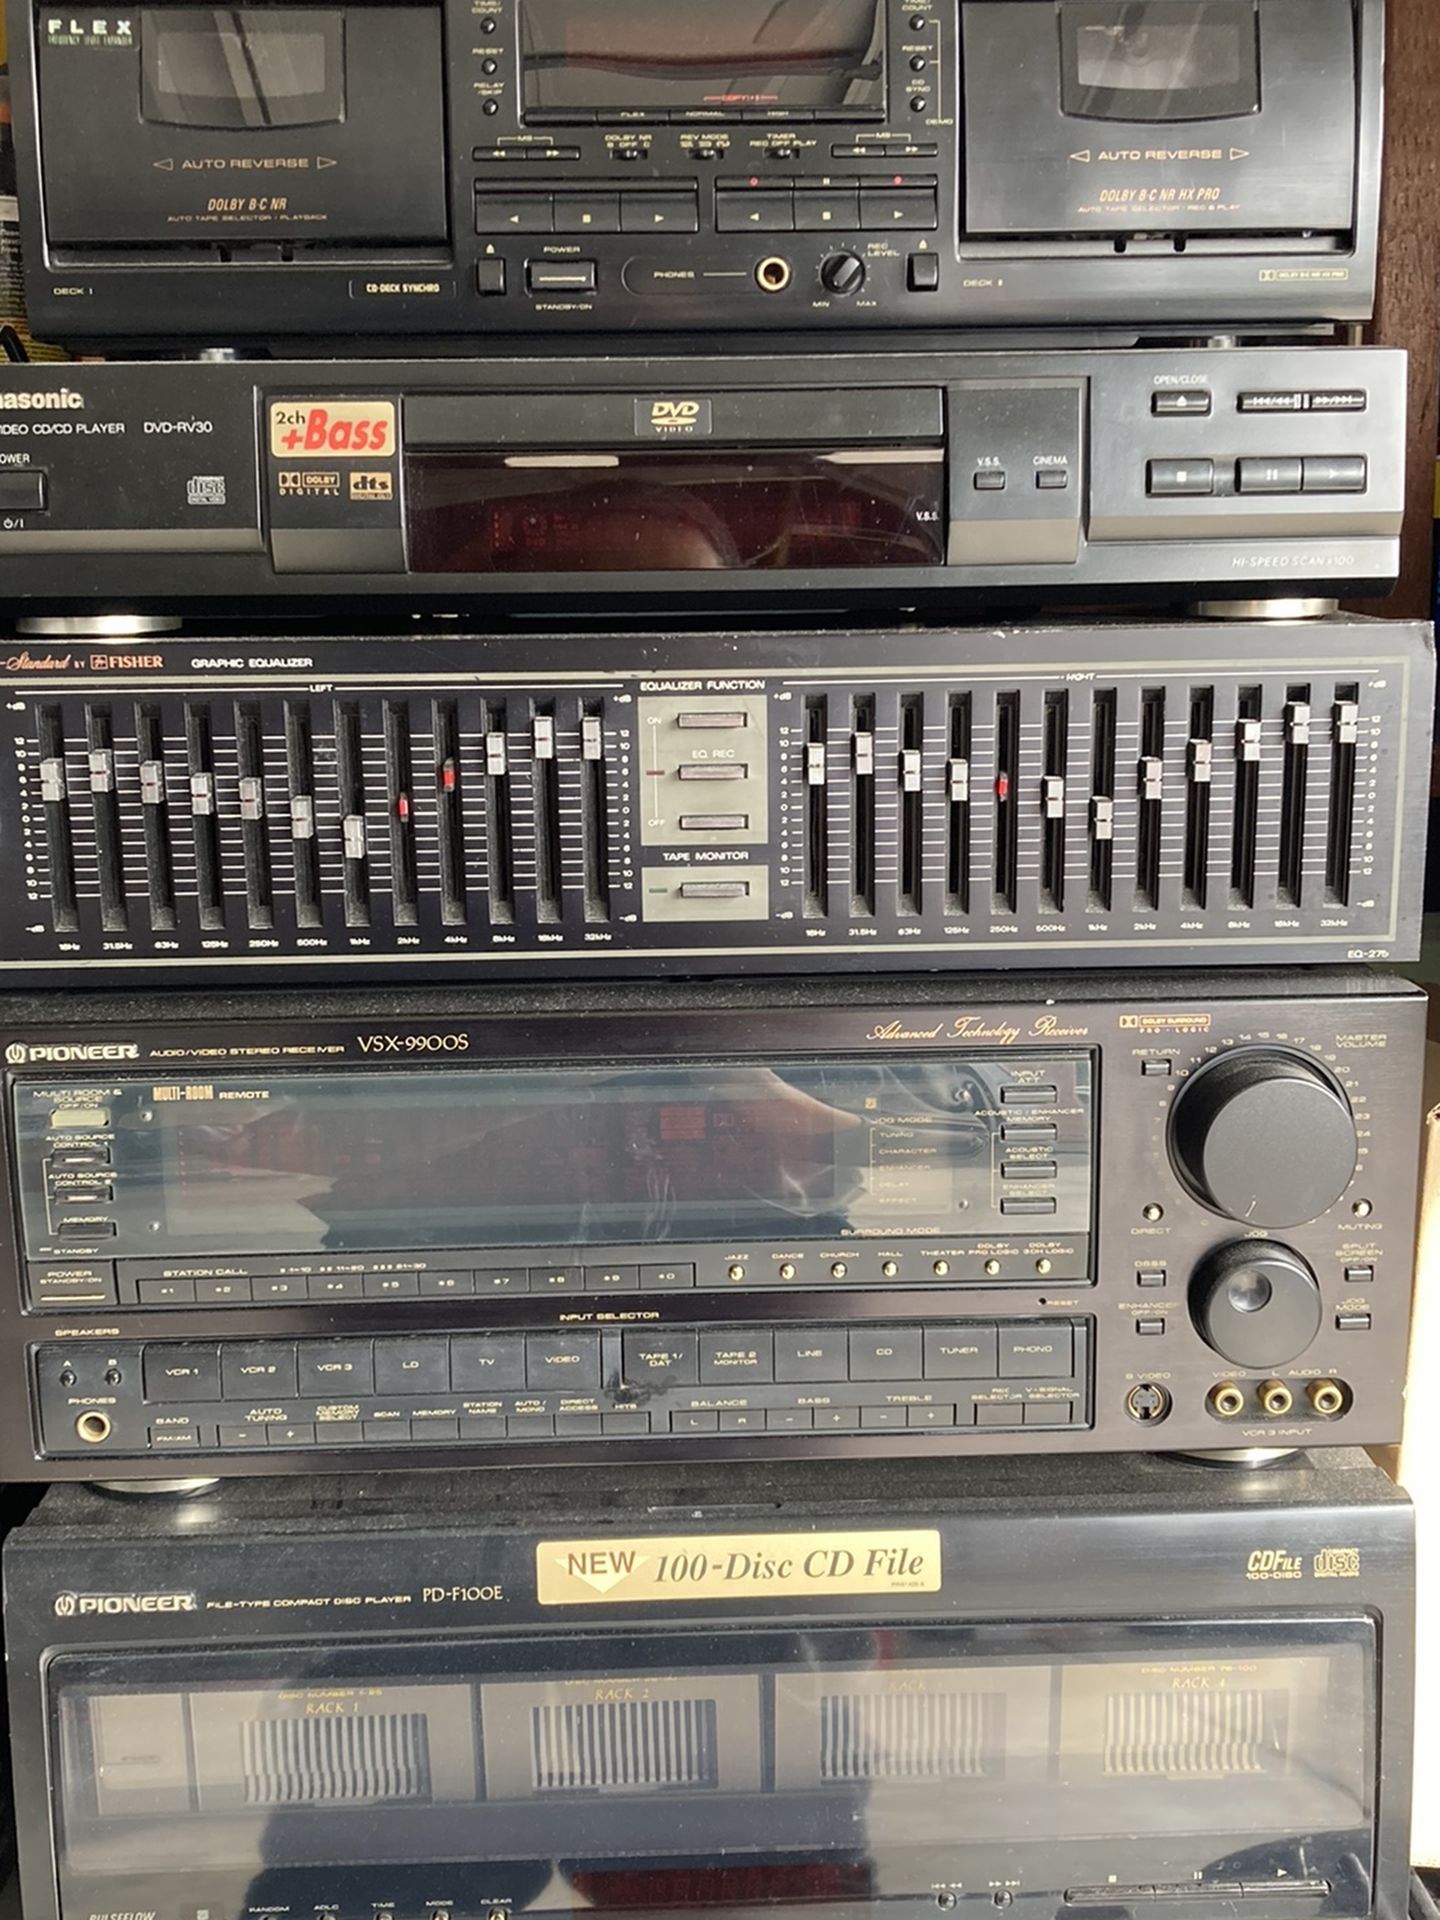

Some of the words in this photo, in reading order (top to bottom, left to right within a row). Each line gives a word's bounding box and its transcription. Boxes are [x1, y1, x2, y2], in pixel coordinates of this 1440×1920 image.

[48, 19, 131, 34] FLEX
[1098, 151, 1141, 161] AUTO
[1145, 149, 1222, 160] REVERSE
[182, 159, 226, 169] AUTO
[230, 158, 309, 169] REVERSE
[1100, 189, 1136, 202] DOLBY
[1159, 189, 1176, 201] NR
[1178, 188, 1195, 201] HX
[1197, 187, 1221, 200] PRO
[207, 198, 245, 211] DOLBY
[270, 198, 288, 210] NR
[279, 213, 328, 221] PLAYBACK
[654, 270, 694, 278] PHONES
[54, 287, 84, 295] DECK
[1153, 375, 1208, 385] OPEN/CLOSE
[651, 402, 699, 417] DVD
[276, 411, 306, 425] 2ch
[32, 423, 72, 435] CD/CD
[76, 422, 125, 434] PLAYER
[144, 421, 213, 434] DVD-RV30
[1033, 456, 1067, 465] CINEMA
[306, 474, 336, 485] DOLBY
[353, 476, 389, 492] dts
[279, 489, 340, 497] DIGITAL
[1232, 557, 1289, 568] HI-SPEED
[1293, 556, 1324, 567] SCAN
[5, 652, 70, 671] Standard
[109, 655, 163, 669] FISHER
[191, 658, 244, 668] GRAPHIC
[249, 658, 313, 668] EQUALIZER
[310, 684, 333, 693] LEFT
[640, 681, 702, 691] EQUALIZER
[707, 680, 766, 690] FUNCTION
[647, 716, 661, 725] ON
[714, 749, 735, 758] REC
[648, 818, 665, 827] OFF
[663, 852, 690, 861] TAPE
[696, 851, 749, 861] MONITOR
[866, 1020, 944, 1040] Advanced
[946, 1016, 1021, 1044] Technology
[1027, 1015, 1090, 1037] Receiver
[1336, 1033, 1387, 1042] MASTER
[357, 1034, 470, 1052] VSX-9900S
[30, 1044, 140, 1061] PIONEER
[149, 1047, 226, 1057] AUDIO/VIDEO
[229, 1047, 279, 1056] STEREO
[282, 1046, 345, 1055] RECEIVER
[1132, 1047, 1181, 1056] RETURN
[153, 1086, 214, 1101] MULTI-ROOM
[219, 1090, 270, 1099] REMOTE
[880, 1147, 937, 1155] CHARACTER
[1337, 1222, 1383, 1231] MUTING
[841, 1227, 904, 1236] SURROUND
[1131, 1227, 1172, 1236] DIRECT
[772, 1252, 804, 1260] DANCE
[48, 1270, 92, 1278] POWER
[163, 1268, 213, 1277] STATION
[216, 1267, 248, 1276] CALL
[559, 1311, 597, 1321] INPUT
[598, 1310, 660, 1320] SELECTOR
[55, 1327, 120, 1337] SPEAKERS
[796, 1349, 823, 1357] LINE
[876, 1347, 893, 1356] CD
[939, 1346, 979, 1354] TUNER
[1013, 1345, 1053, 1353] PHONO
[544, 1356, 580, 1364] VIDEO
[716, 1352, 743, 1360] TAPE
[402, 1360, 419, 1369] LD
[479, 1358, 495, 1367] TV
[649, 1359, 672, 1367] DAT
[713, 1358, 758, 1366] MONITOR
[166, 1368, 190, 1376] VCR
[241, 1366, 267, 1375] VCR
[316, 1364, 342, 1373] VCR
[1288, 1369, 1321, 1377] AUDIO
[68, 1396, 117, 1406] PHONES
[560, 1398, 595, 1406] DIRECT
[797, 1395, 830, 1405] BASS
[885, 1393, 933, 1402] TREBLE
[691, 1398, 748, 1408] BALANCE
[249, 1407, 283, 1416] AUTO
[412, 1408, 457, 1417] MEMORY
[559, 1404, 599, 1412] ACCESS
[246, 1414, 288, 1422] TUNING
[373, 1410, 400, 1418] SCAN
[156, 1416, 190, 1425] BAND
[1242, 1429, 1267, 1438] VCR
[567, 1550, 637, 1577] NEW
[652, 1551, 793, 1584] 100-Disc
[803, 1548, 856, 1580] CD
[863, 1547, 924, 1577] File
[422, 1585, 504, 1603] PD-F100E
[79, 1593, 195, 1614] PIONEER
[206, 1599, 271, 1609] FILE-TYPE
[273, 1598, 331, 1608] COMPACT
[333, 1597, 361, 1606] DISC
[365, 1595, 413, 1605] PLAYER
[1171, 1677, 1209, 1689] RACK
[595, 1688, 634, 1700] RACK
[305, 1702, 346, 1715] RACK
[371, 1902, 396, 1910] TIME
[426, 1899, 454, 1907] MODE
[481, 1897, 512, 1906] CLEAR
[249, 1906, 290, 1914] RANDOM
